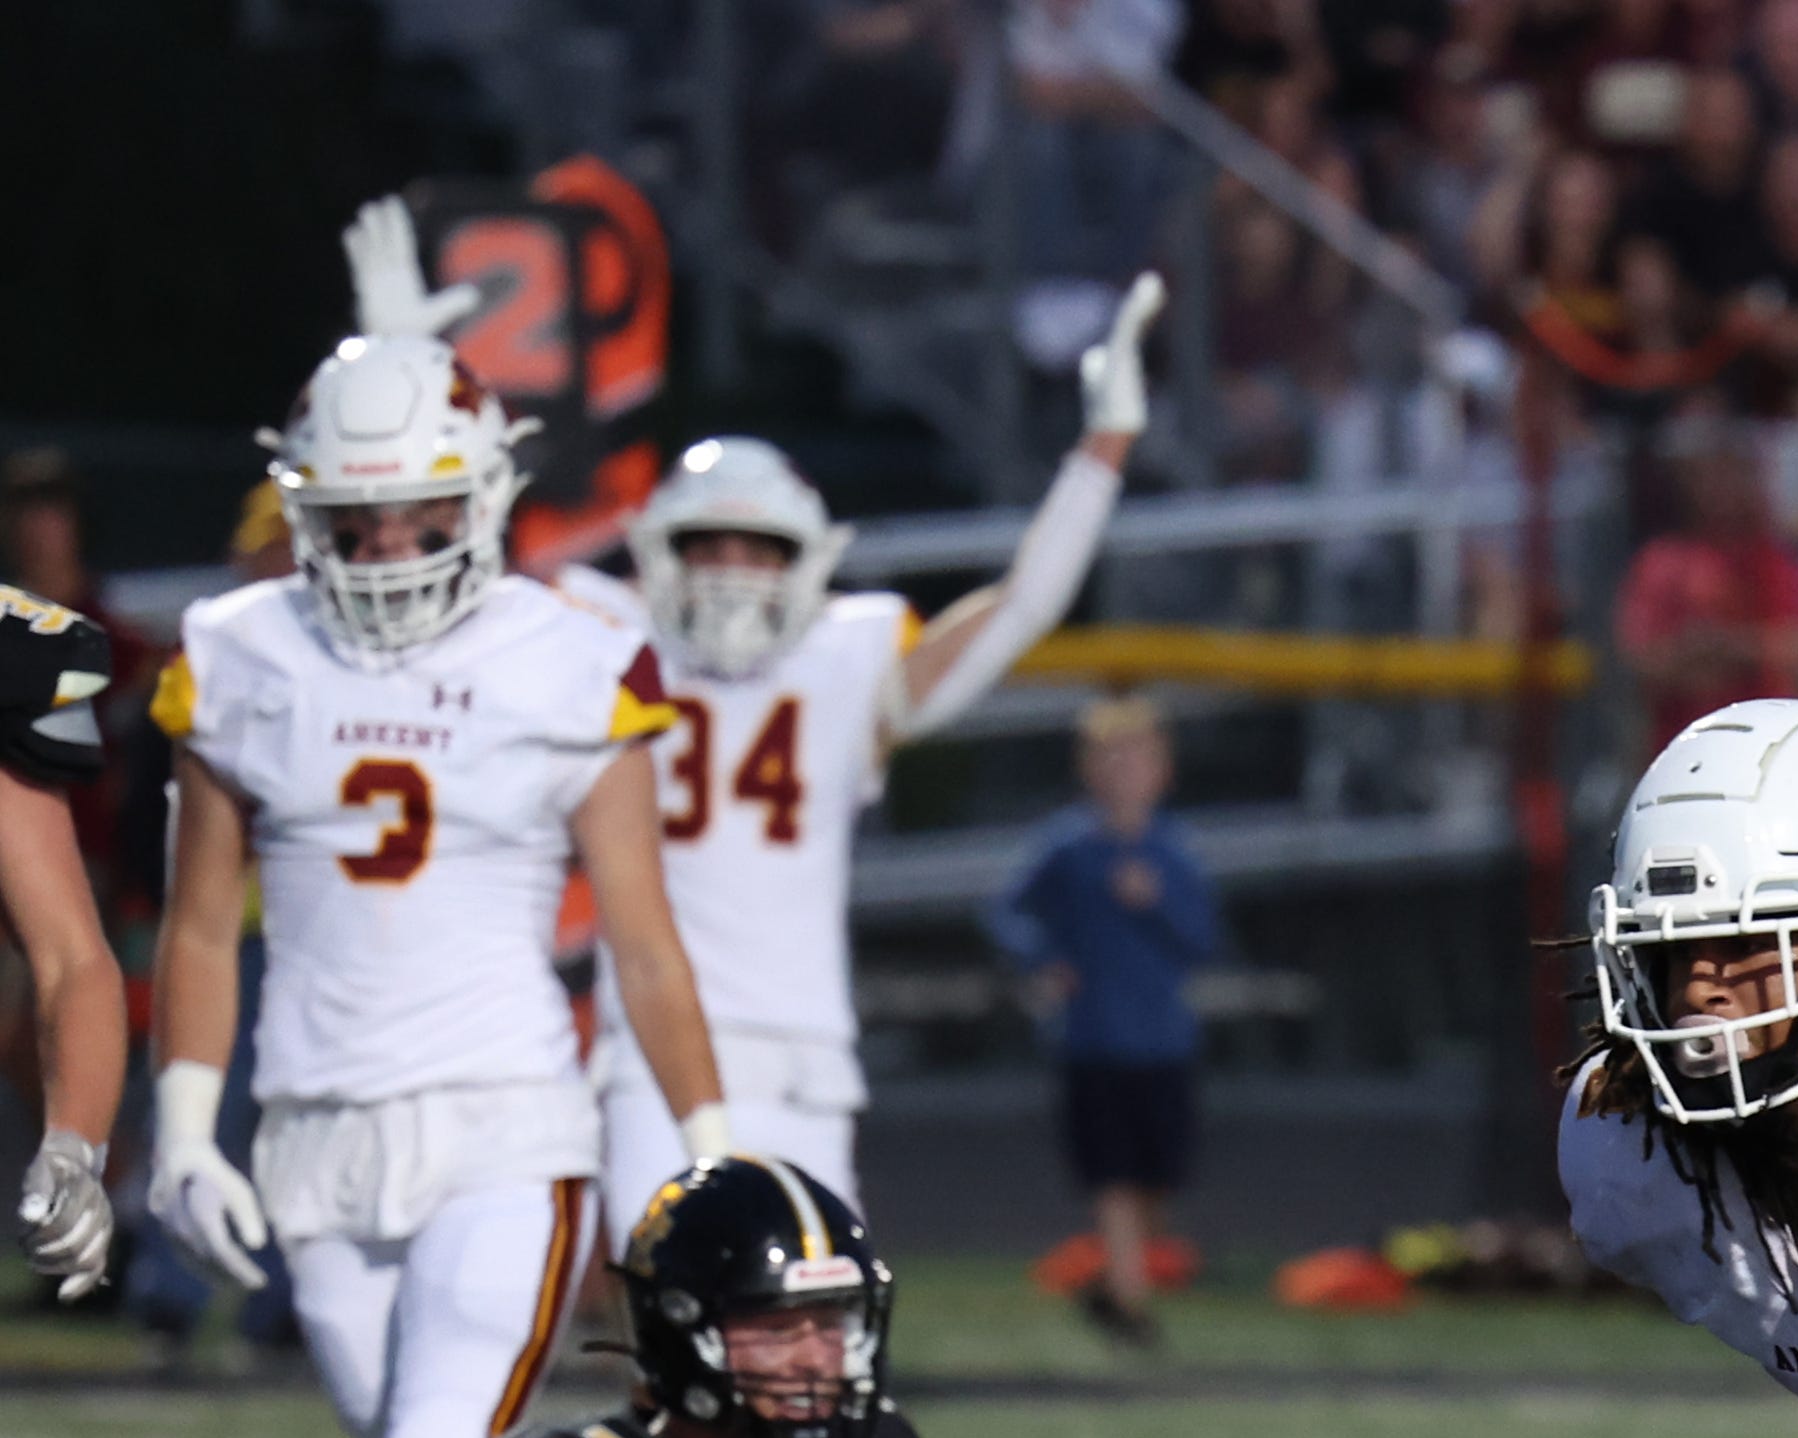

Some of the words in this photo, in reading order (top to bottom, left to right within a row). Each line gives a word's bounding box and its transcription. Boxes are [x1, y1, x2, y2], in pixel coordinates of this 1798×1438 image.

[438, 215, 570, 392] 2
[332, 755, 436, 889] 3
[652, 692, 806, 846] 34
